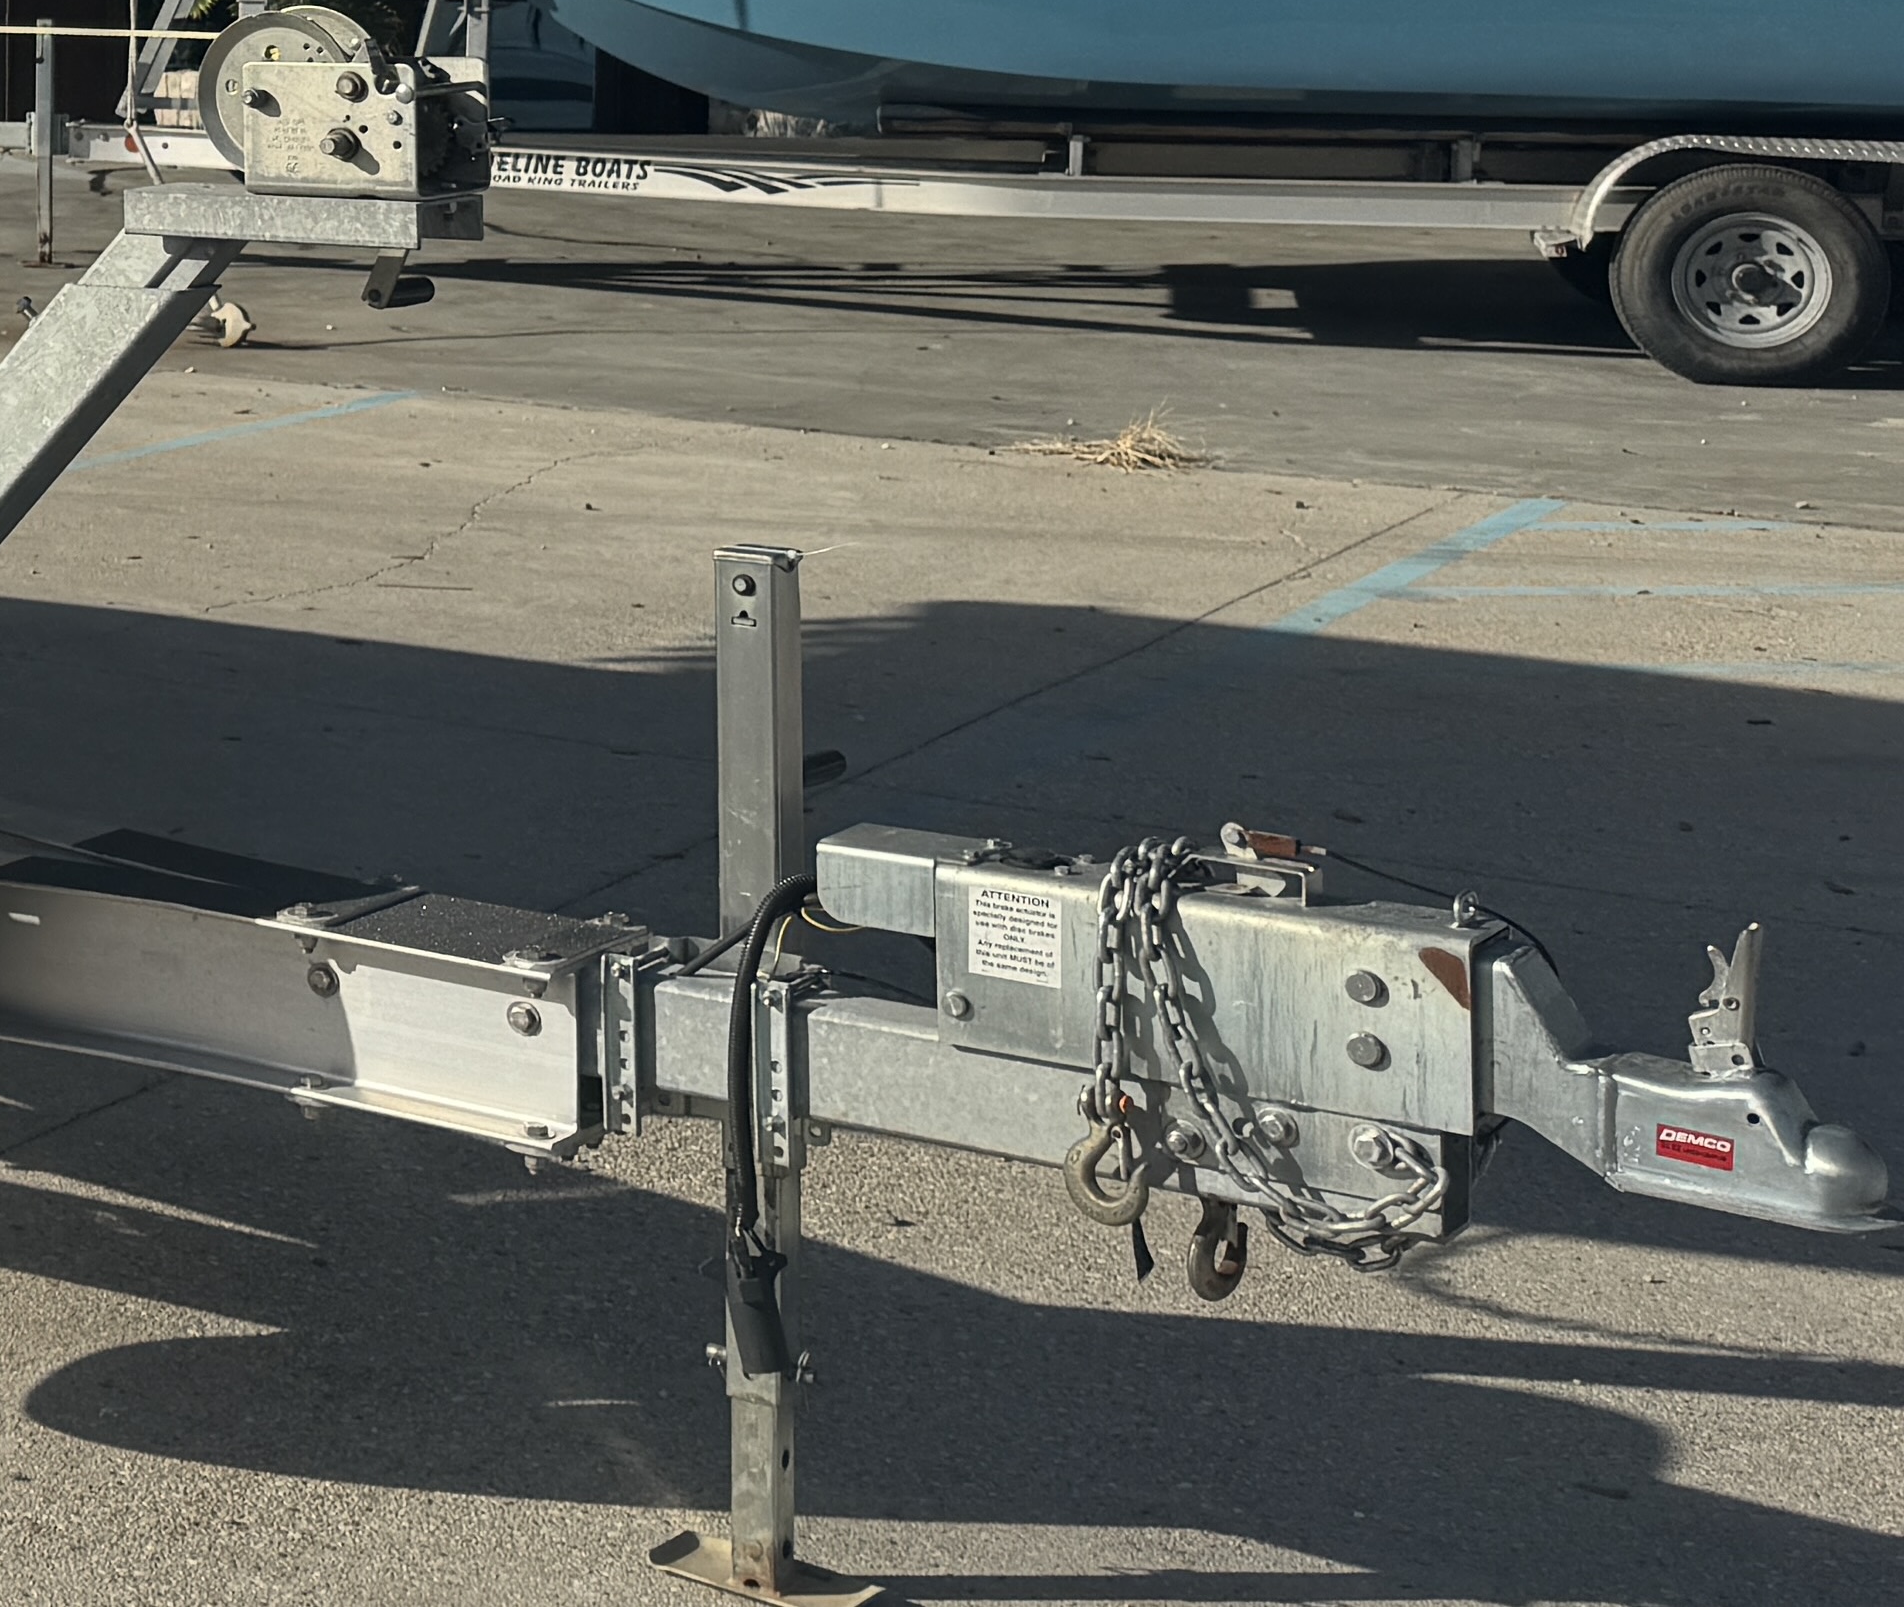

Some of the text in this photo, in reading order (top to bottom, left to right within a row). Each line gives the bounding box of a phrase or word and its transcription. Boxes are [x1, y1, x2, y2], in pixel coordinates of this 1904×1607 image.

[575, 156, 651, 180] BOATS
[527, 176, 563, 186] KING
[570, 179, 639, 191] TRAILERS
[981, 890, 1049, 908] ATTENTION
[1009, 954, 1032, 965] MUST
[1659, 1128, 1732, 1153] DEMCO
